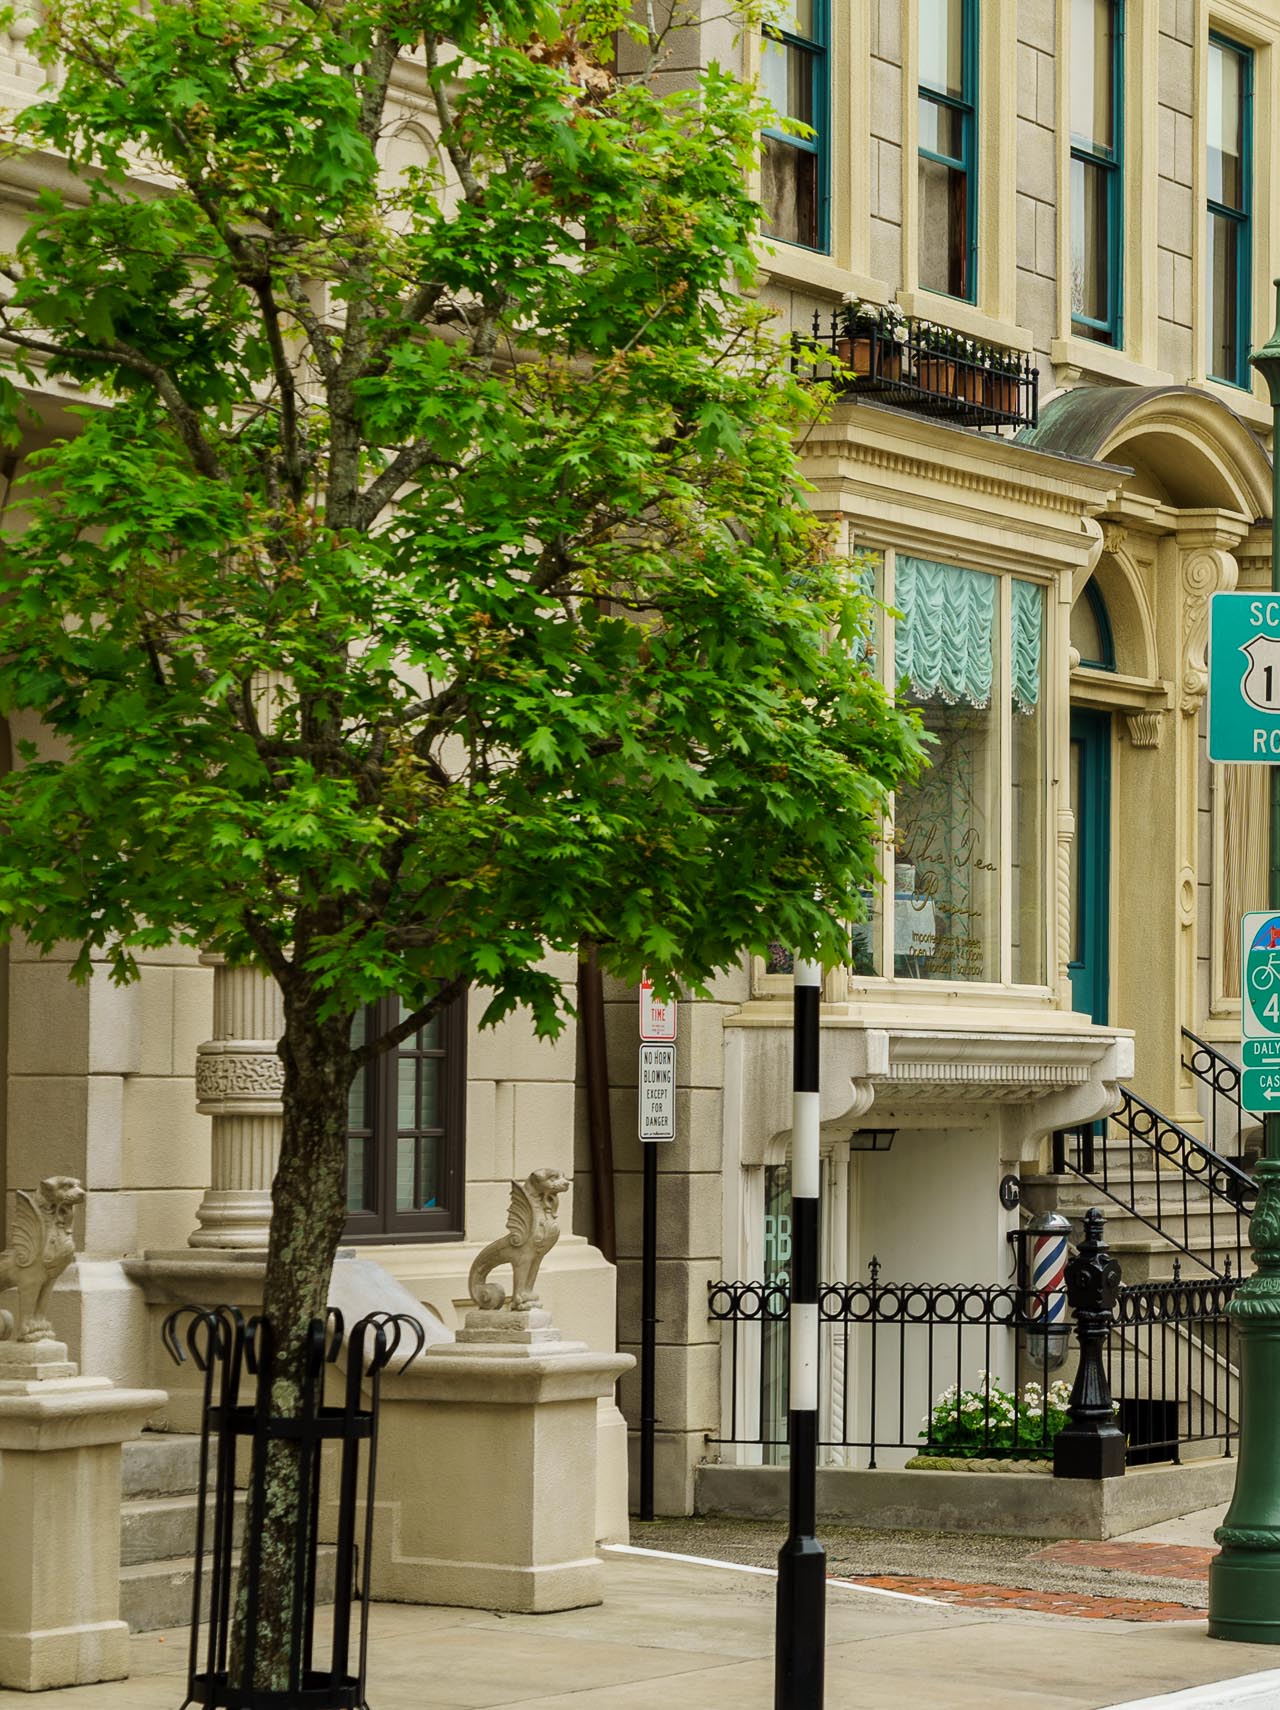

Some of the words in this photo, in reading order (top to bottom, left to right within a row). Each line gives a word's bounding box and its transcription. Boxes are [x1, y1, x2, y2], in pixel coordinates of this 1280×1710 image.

[953, 828, 998, 871] Tea
[651, 1008, 666, 1021] TIME
[1253, 1042, 1280, 1055] DALY
[644, 1052, 653, 1065] NO
[654, 1051, 672, 1065] HORN
[644, 1070, 671, 1083] BLOWING
[647, 1088, 668, 1100] EXCEPT
[651, 1102, 663, 1113] FOR
[645, 1116, 669, 1127] DANGER
